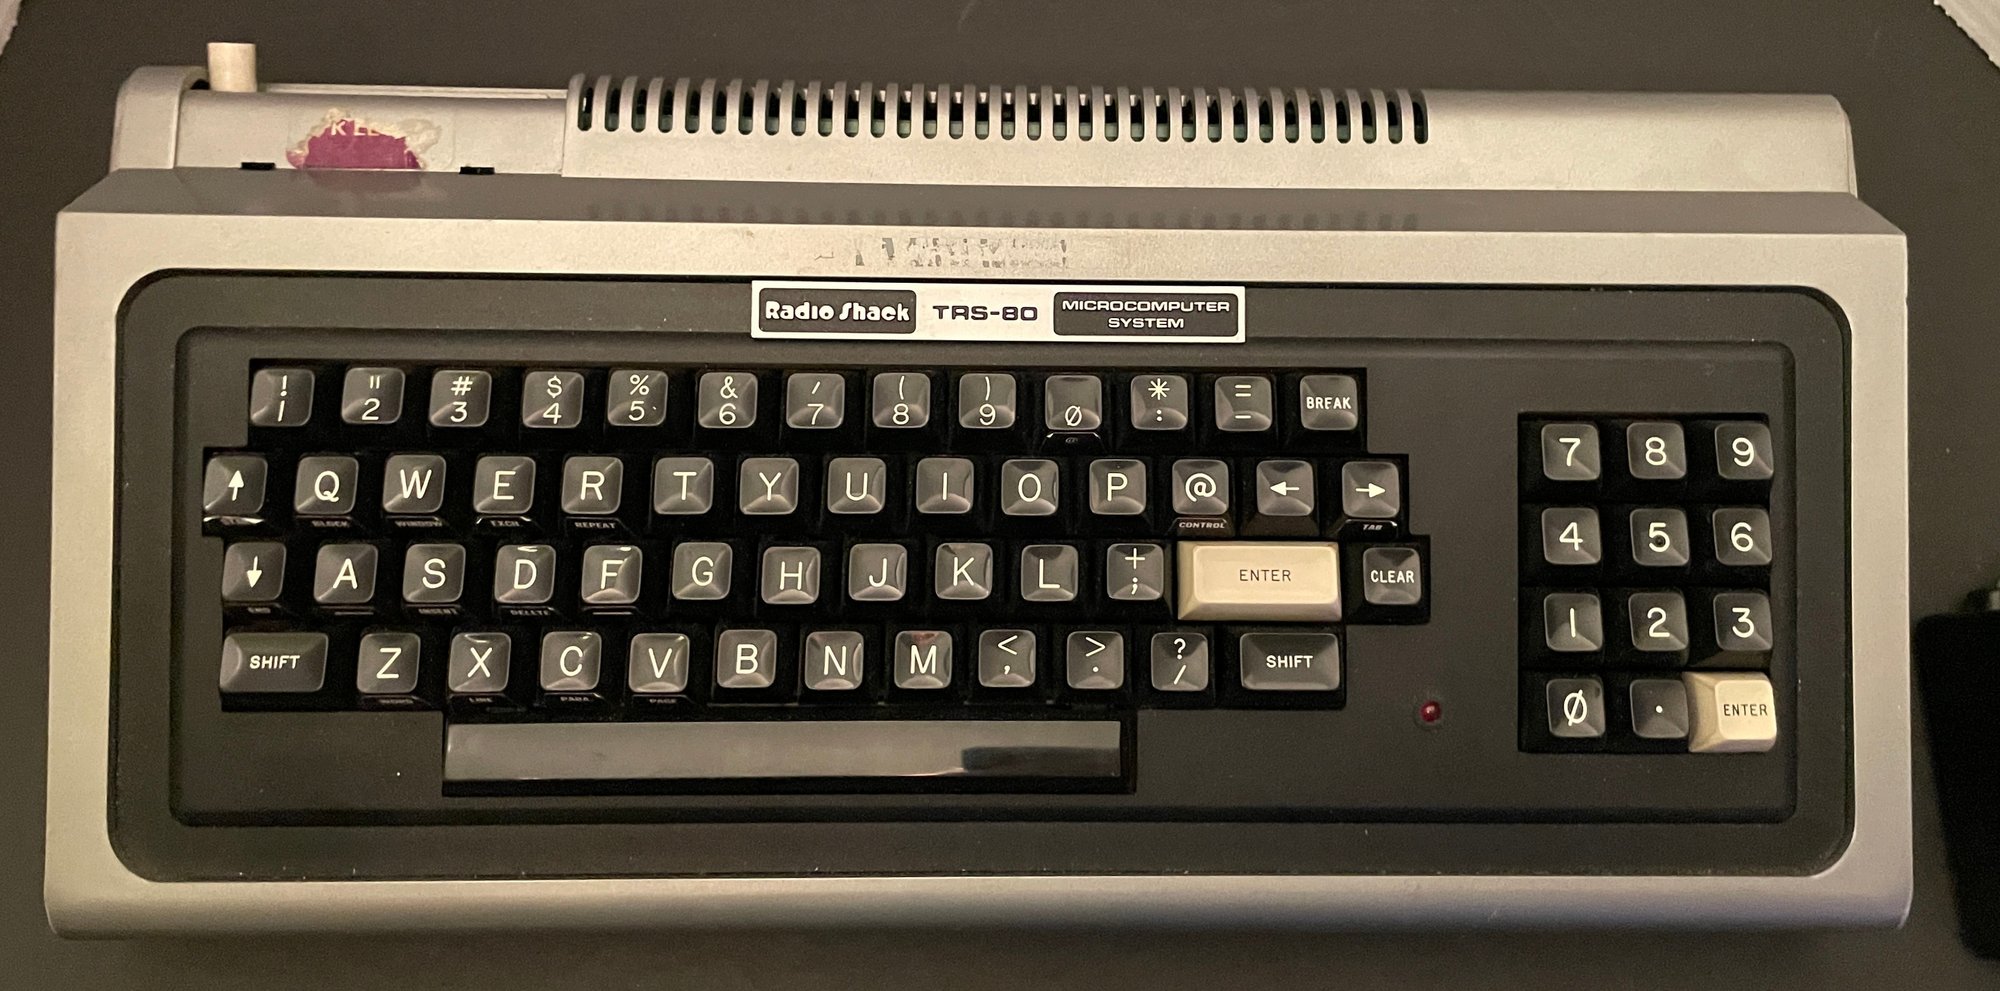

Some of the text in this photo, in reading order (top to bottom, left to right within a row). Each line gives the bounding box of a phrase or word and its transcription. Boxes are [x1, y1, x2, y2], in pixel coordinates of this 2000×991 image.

[765, 300, 910, 323] Radio Shack
[933, 305, 1038, 322] TRS-80
[1062, 299, 1230, 314] MICROCOMPUTER
[1108, 318, 1184, 329] SYSTEM
[280, 375, 288, 397] !
[450, 375, 474, 396] #
[546, 375, 563, 399] $
[629, 374, 650, 396] %
[720, 375, 739, 399] &
[898, 375, 905, 400] (
[985, 376, 991, 401] )
[1234, 384, 1252, 397] =
[277, 400, 285, 422] 1
[361, 397, 380, 421] 2
[450, 401, 468, 423] 3
[542, 402, 562, 425] 4
[628, 400, 645, 421] 5
[718, 402, 737, 425] 6
[807, 403, 825, 425] 7
[892, 403, 910, 425] 8
[979, 403, 996, 426] 9
[1306, 396, 1352, 410] BREAK
[1559, 437, 1581, 467] 7
[1645, 436, 1667, 466] 8
[1732, 437, 1755, 467] 9
[314, 470, 340, 503] Q
[396, 468, 432, 500] W
[492, 470, 517, 500] E
[580, 470, 605, 501] R
[673, 471, 697, 501] T
[759, 472, 784, 501] Y
[845, 472, 868, 501] U
[942, 472, 948, 501] I
[1018, 473, 1042, 503] O
[1107, 472, 1128, 502] P
[1185, 472, 1217, 502] @
[573, 520, 617, 530] REPEAT
[1177, 521, 1226, 531] CONTROL
[1361, 523, 1383, 532] TAB
[1559, 522, 1584, 552] 4
[1648, 522, 1671, 553] 5
[1730, 522, 1754, 552] 6
[1124, 547, 1146, 570] +
[332, 558, 358, 590] A
[422, 558, 446, 589] S
[513, 559, 537, 590] D
[600, 559, 624, 591] F
[691, 556, 714, 587] G
[779, 561, 803, 591] H
[868, 558, 889, 589] J
[953, 556, 975, 587] K
[1038, 558, 1061, 589] L
[1239, 569, 1291, 582] ENTER
[1370, 569, 1415, 584] CLEAR
[1131, 577, 1138, 595] ;
[509, 609, 550, 617] DELETE
[1569, 607, 1577, 638] 1
[1647, 607, 1671, 638] 2
[1732, 607, 1755, 639] 3
[997, 635, 1018, 656] <
[1085, 636, 1106, 657] >
[1173, 637, 1186, 660] ?
[249, 654, 301, 670] SHIFT
[376, 647, 402, 679] Z
[467, 647, 493, 678] X
[559, 645, 583, 677] C
[648, 647, 673, 679] V
[735, 643, 759, 675] B
[823, 645, 847, 676] N
[910, 644, 937, 675] M
[1266, 654, 1314, 669] SHIFT
[1173, 664, 1187, 685] /
[1723, 703, 1768, 717] ENTER
